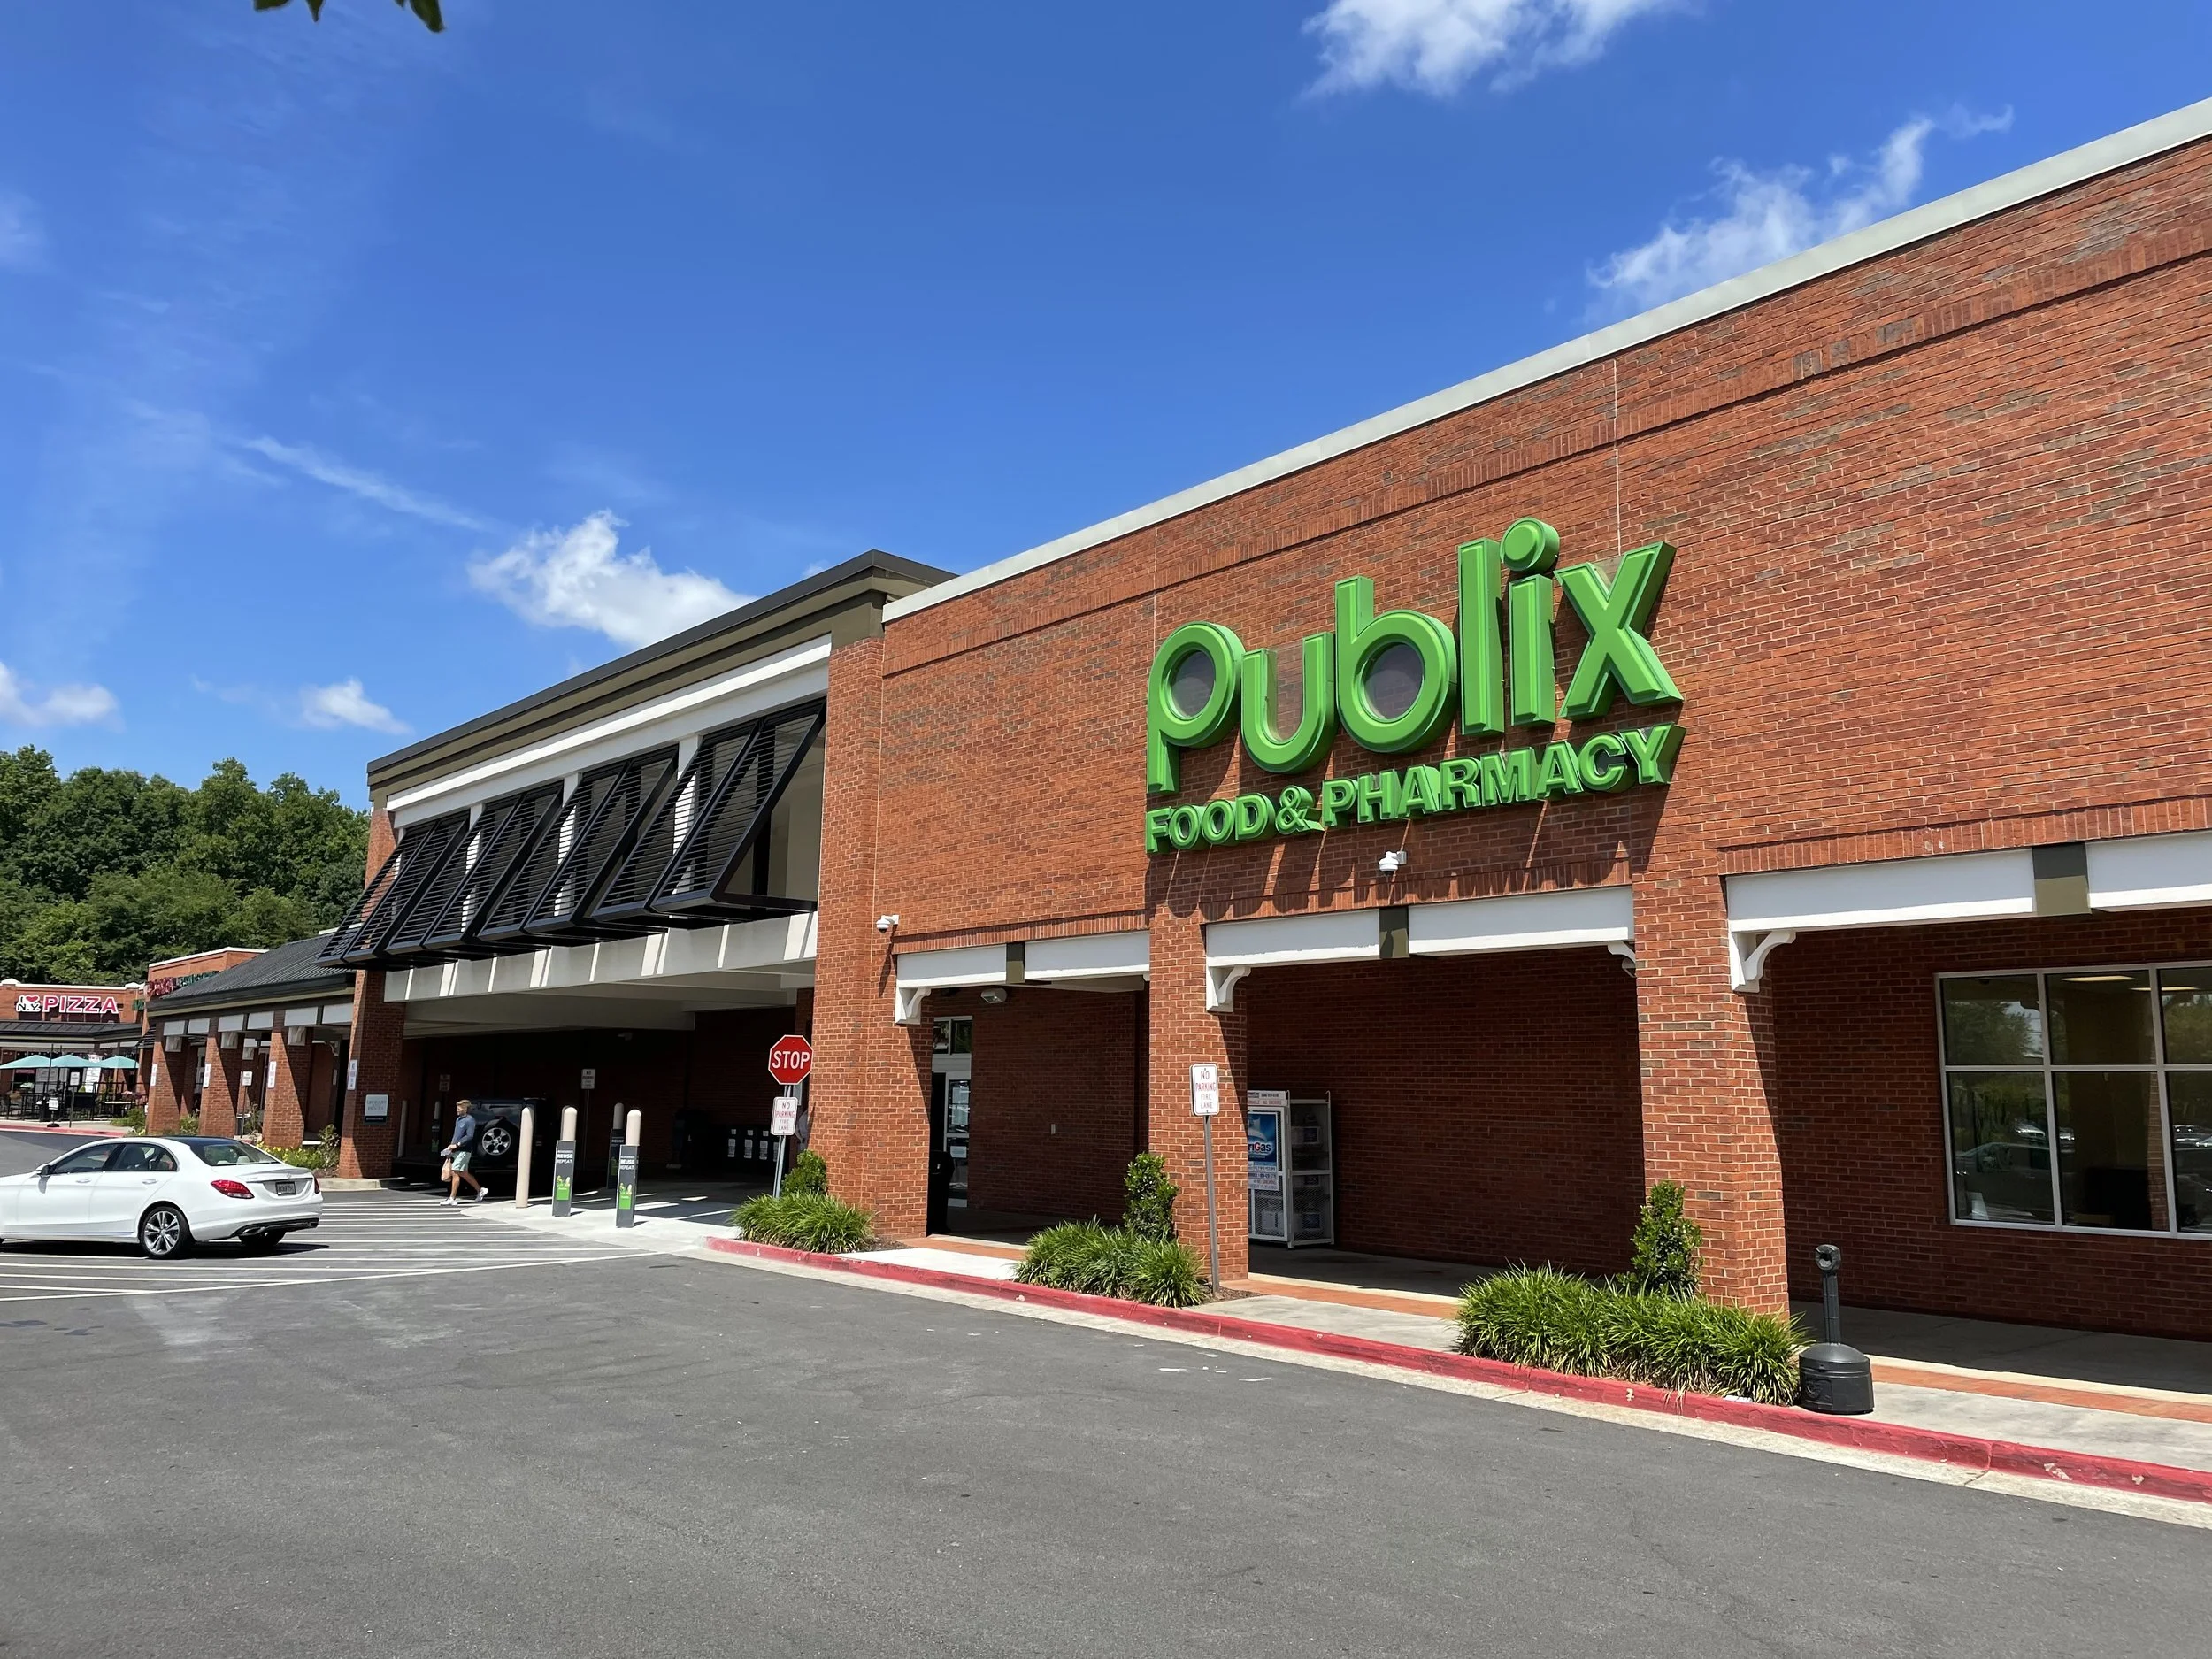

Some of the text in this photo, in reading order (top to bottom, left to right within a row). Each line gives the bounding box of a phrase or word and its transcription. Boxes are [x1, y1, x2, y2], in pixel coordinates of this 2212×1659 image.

[1145, 722, 1686, 854] FOOD & PHARMACY
[42, 995, 119, 1014] PIZZA
[772, 1050, 810, 1070] STOP
[1200, 1071, 1210, 1080] NO
[1195, 1082, 1217, 1092] PARKING
